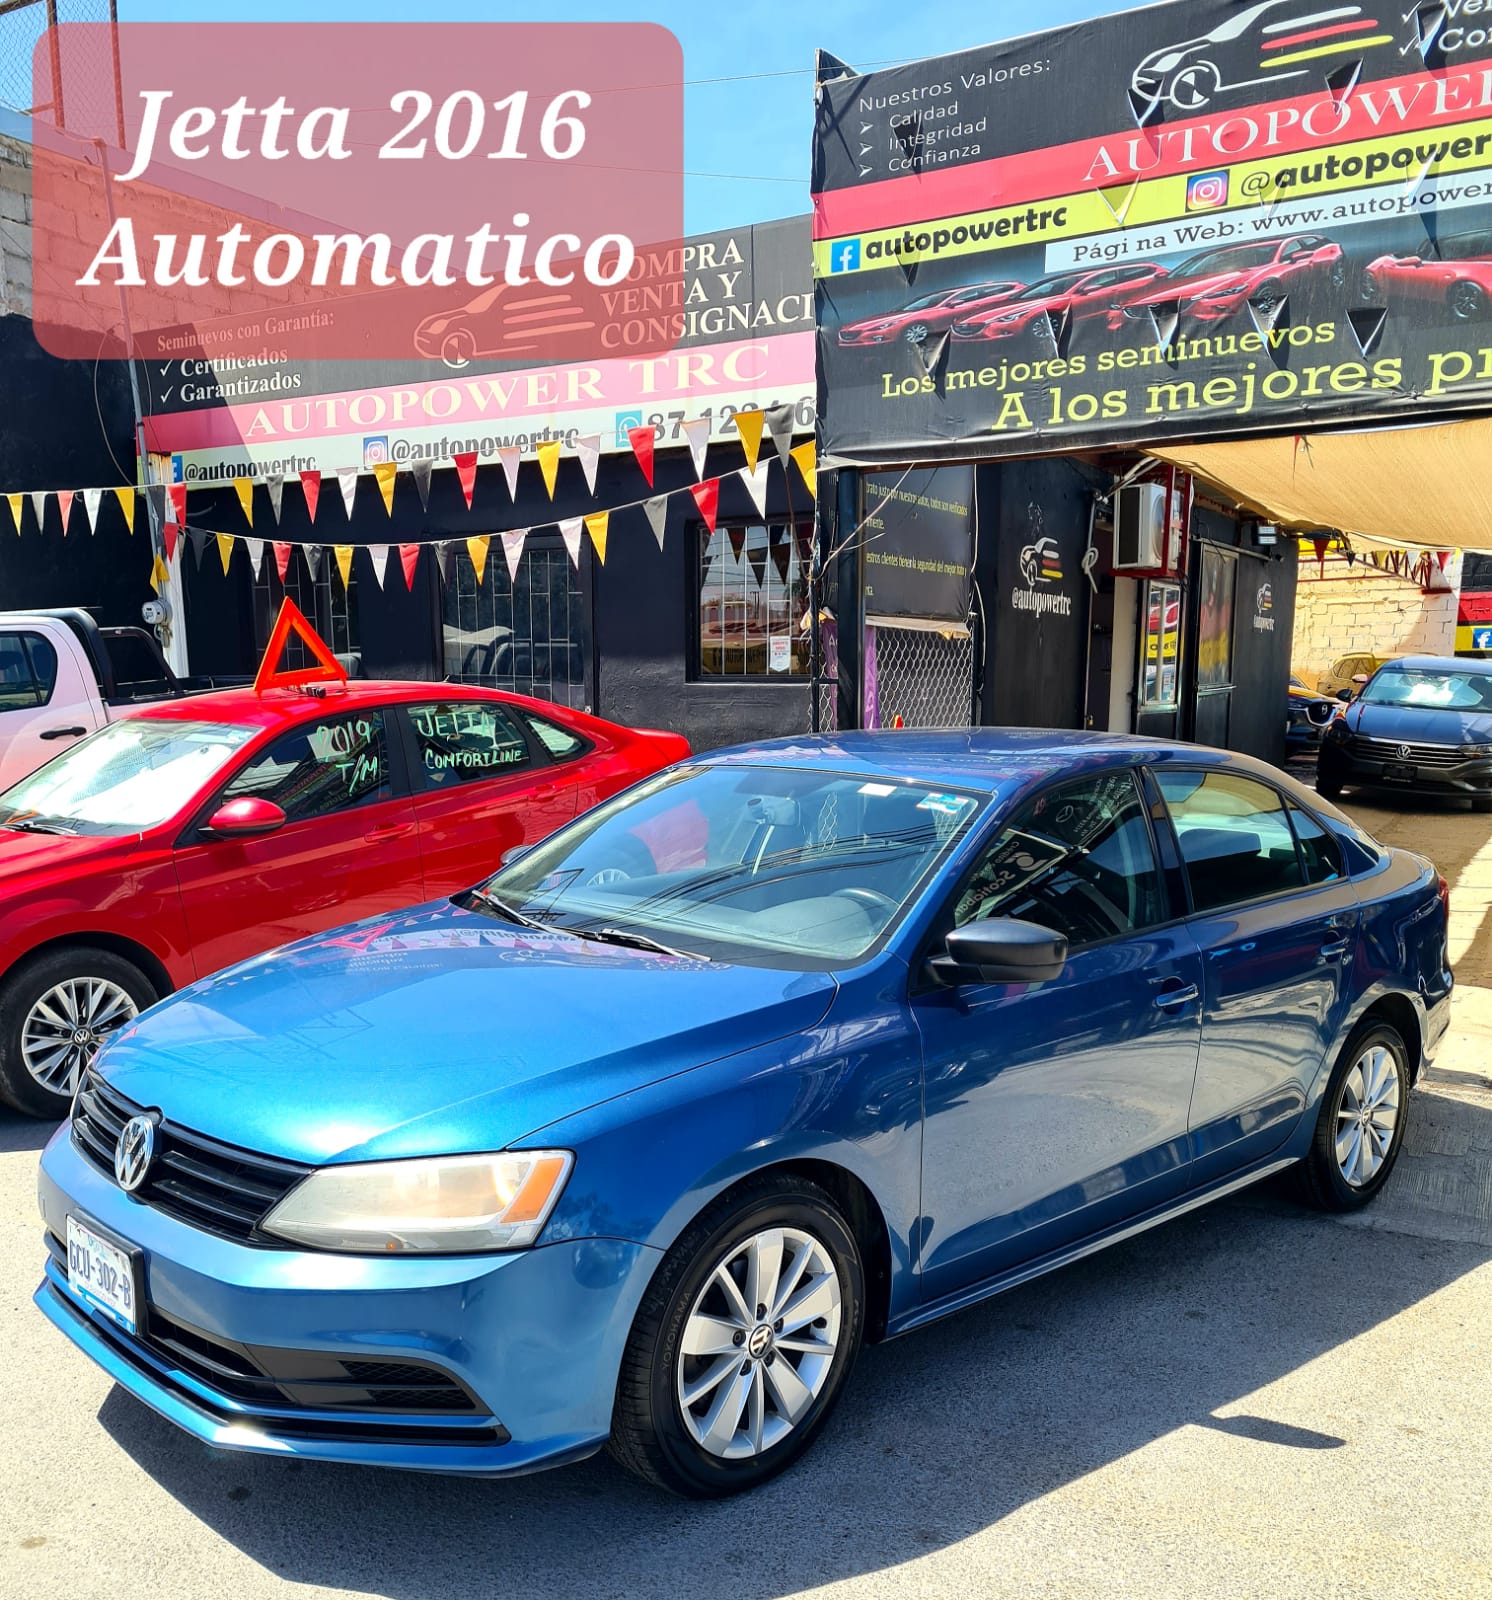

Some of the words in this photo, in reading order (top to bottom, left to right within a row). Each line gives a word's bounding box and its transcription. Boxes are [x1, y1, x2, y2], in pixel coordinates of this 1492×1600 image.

[1443, 0, 1492, 19] Ve
[1438, 27, 1492, 51] Co
[859, 81, 953, 113] Nuestros
[961, 59, 1051, 90] Valores:
[889, 101, 958, 129] Calidad
[889, 117, 988, 151] Integridad
[888, 143, 981, 172] Confianza
[866, 206, 1068, 259] autopowertrc
[1174, 219, 1244, 242] Web:
[600, 276, 709, 317] VENTA
[717, 270, 742, 299] Y
[157, 327, 234, 352] Seminuevos
[237, 321, 261, 339] con
[264, 309, 335, 335] Garantía:
[601, 291, 814, 349] CONSIGNACI
[180, 348, 289, 378] Certificados
[882, 373, 937, 398] Los
[948, 355, 1086, 398] mejores
[1098, 321, 1336, 372] seminuevos
[180, 371, 302, 403] Garantizados
[245, 367, 607, 437] AUTOPOWER
[628, 343, 770, 394] TRC
[992, 390, 1033, 431] A
[1049, 387, 1128, 425] los
[1147, 352, 1403, 415] mejores
[392, 426, 579, 464] @autopowertrc
[184, 455, 317, 482] @autopowertrc
[1012, 586, 1071, 619] @autopowertrc
[316, 719, 372, 763] 2019
[69, 1239, 131, 1309] GCU-302-B
[662, 1290, 692, 1369] YOKOHAMA
